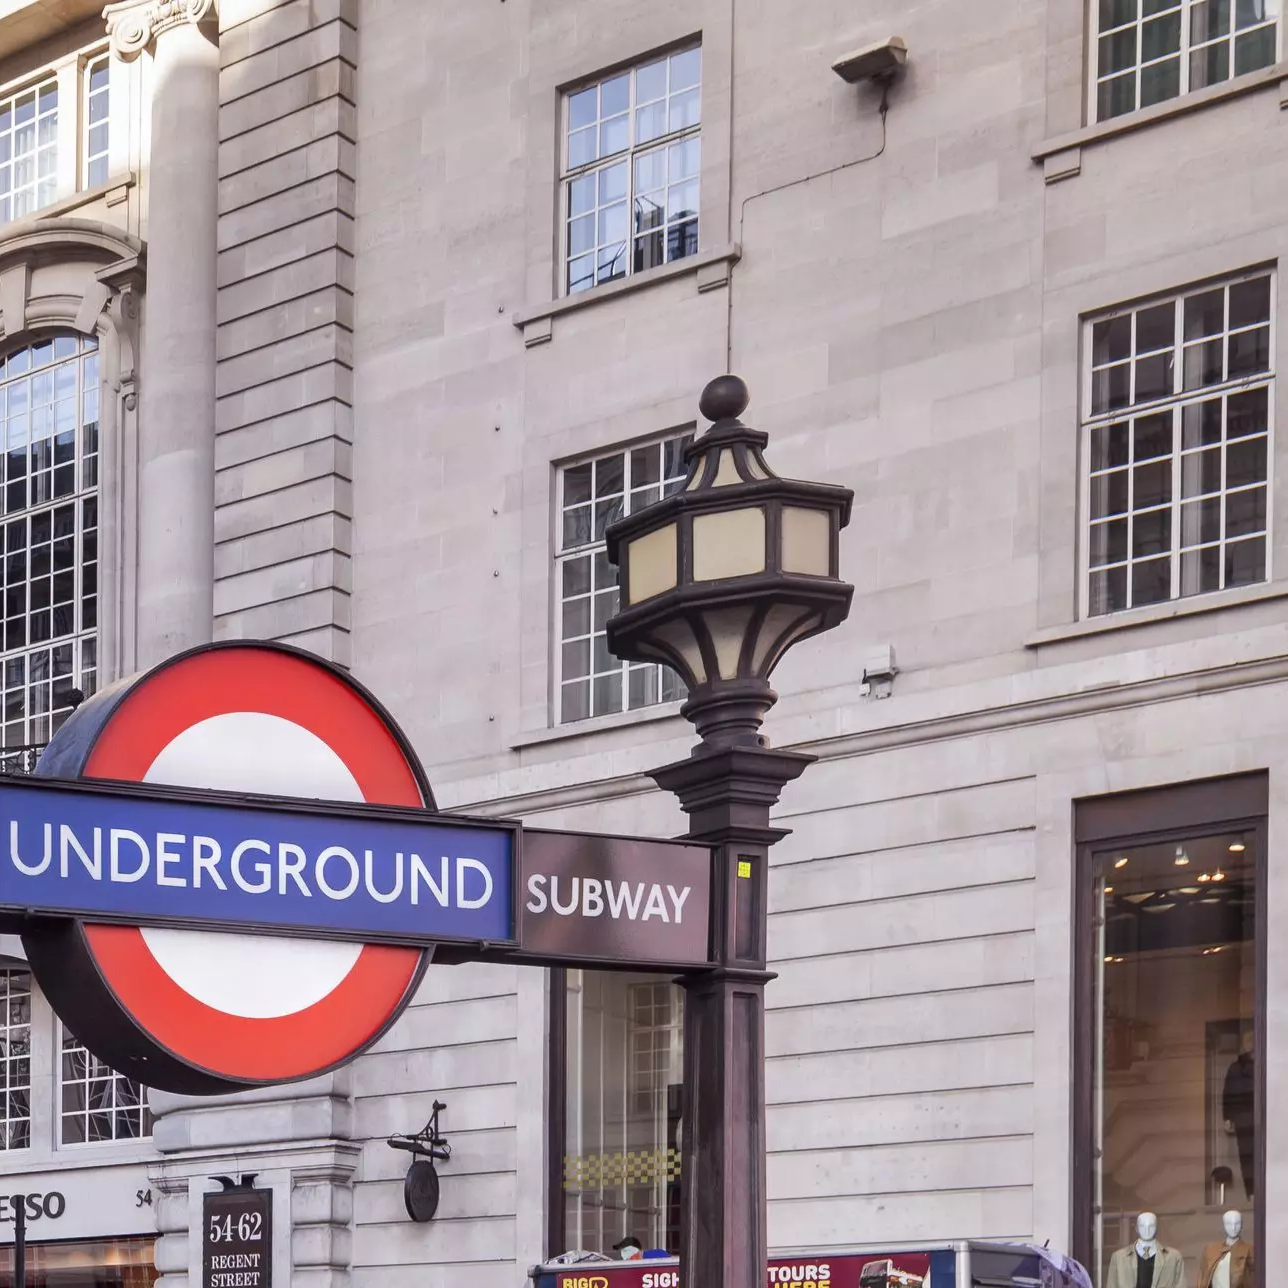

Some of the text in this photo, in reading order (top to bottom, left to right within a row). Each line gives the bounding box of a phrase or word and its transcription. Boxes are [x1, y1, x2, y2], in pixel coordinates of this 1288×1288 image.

[9, 819, 494, 910] UNDERGROUND
[526, 873, 692, 924] SUBWAY
[136, 1188, 152, 1208] 54
[209, 1212, 262, 1242] 54-62
[211, 1253, 260, 1269] REGENT
[211, 1271, 260, 1287] STREET
[767, 1264, 831, 1282] TOURS
